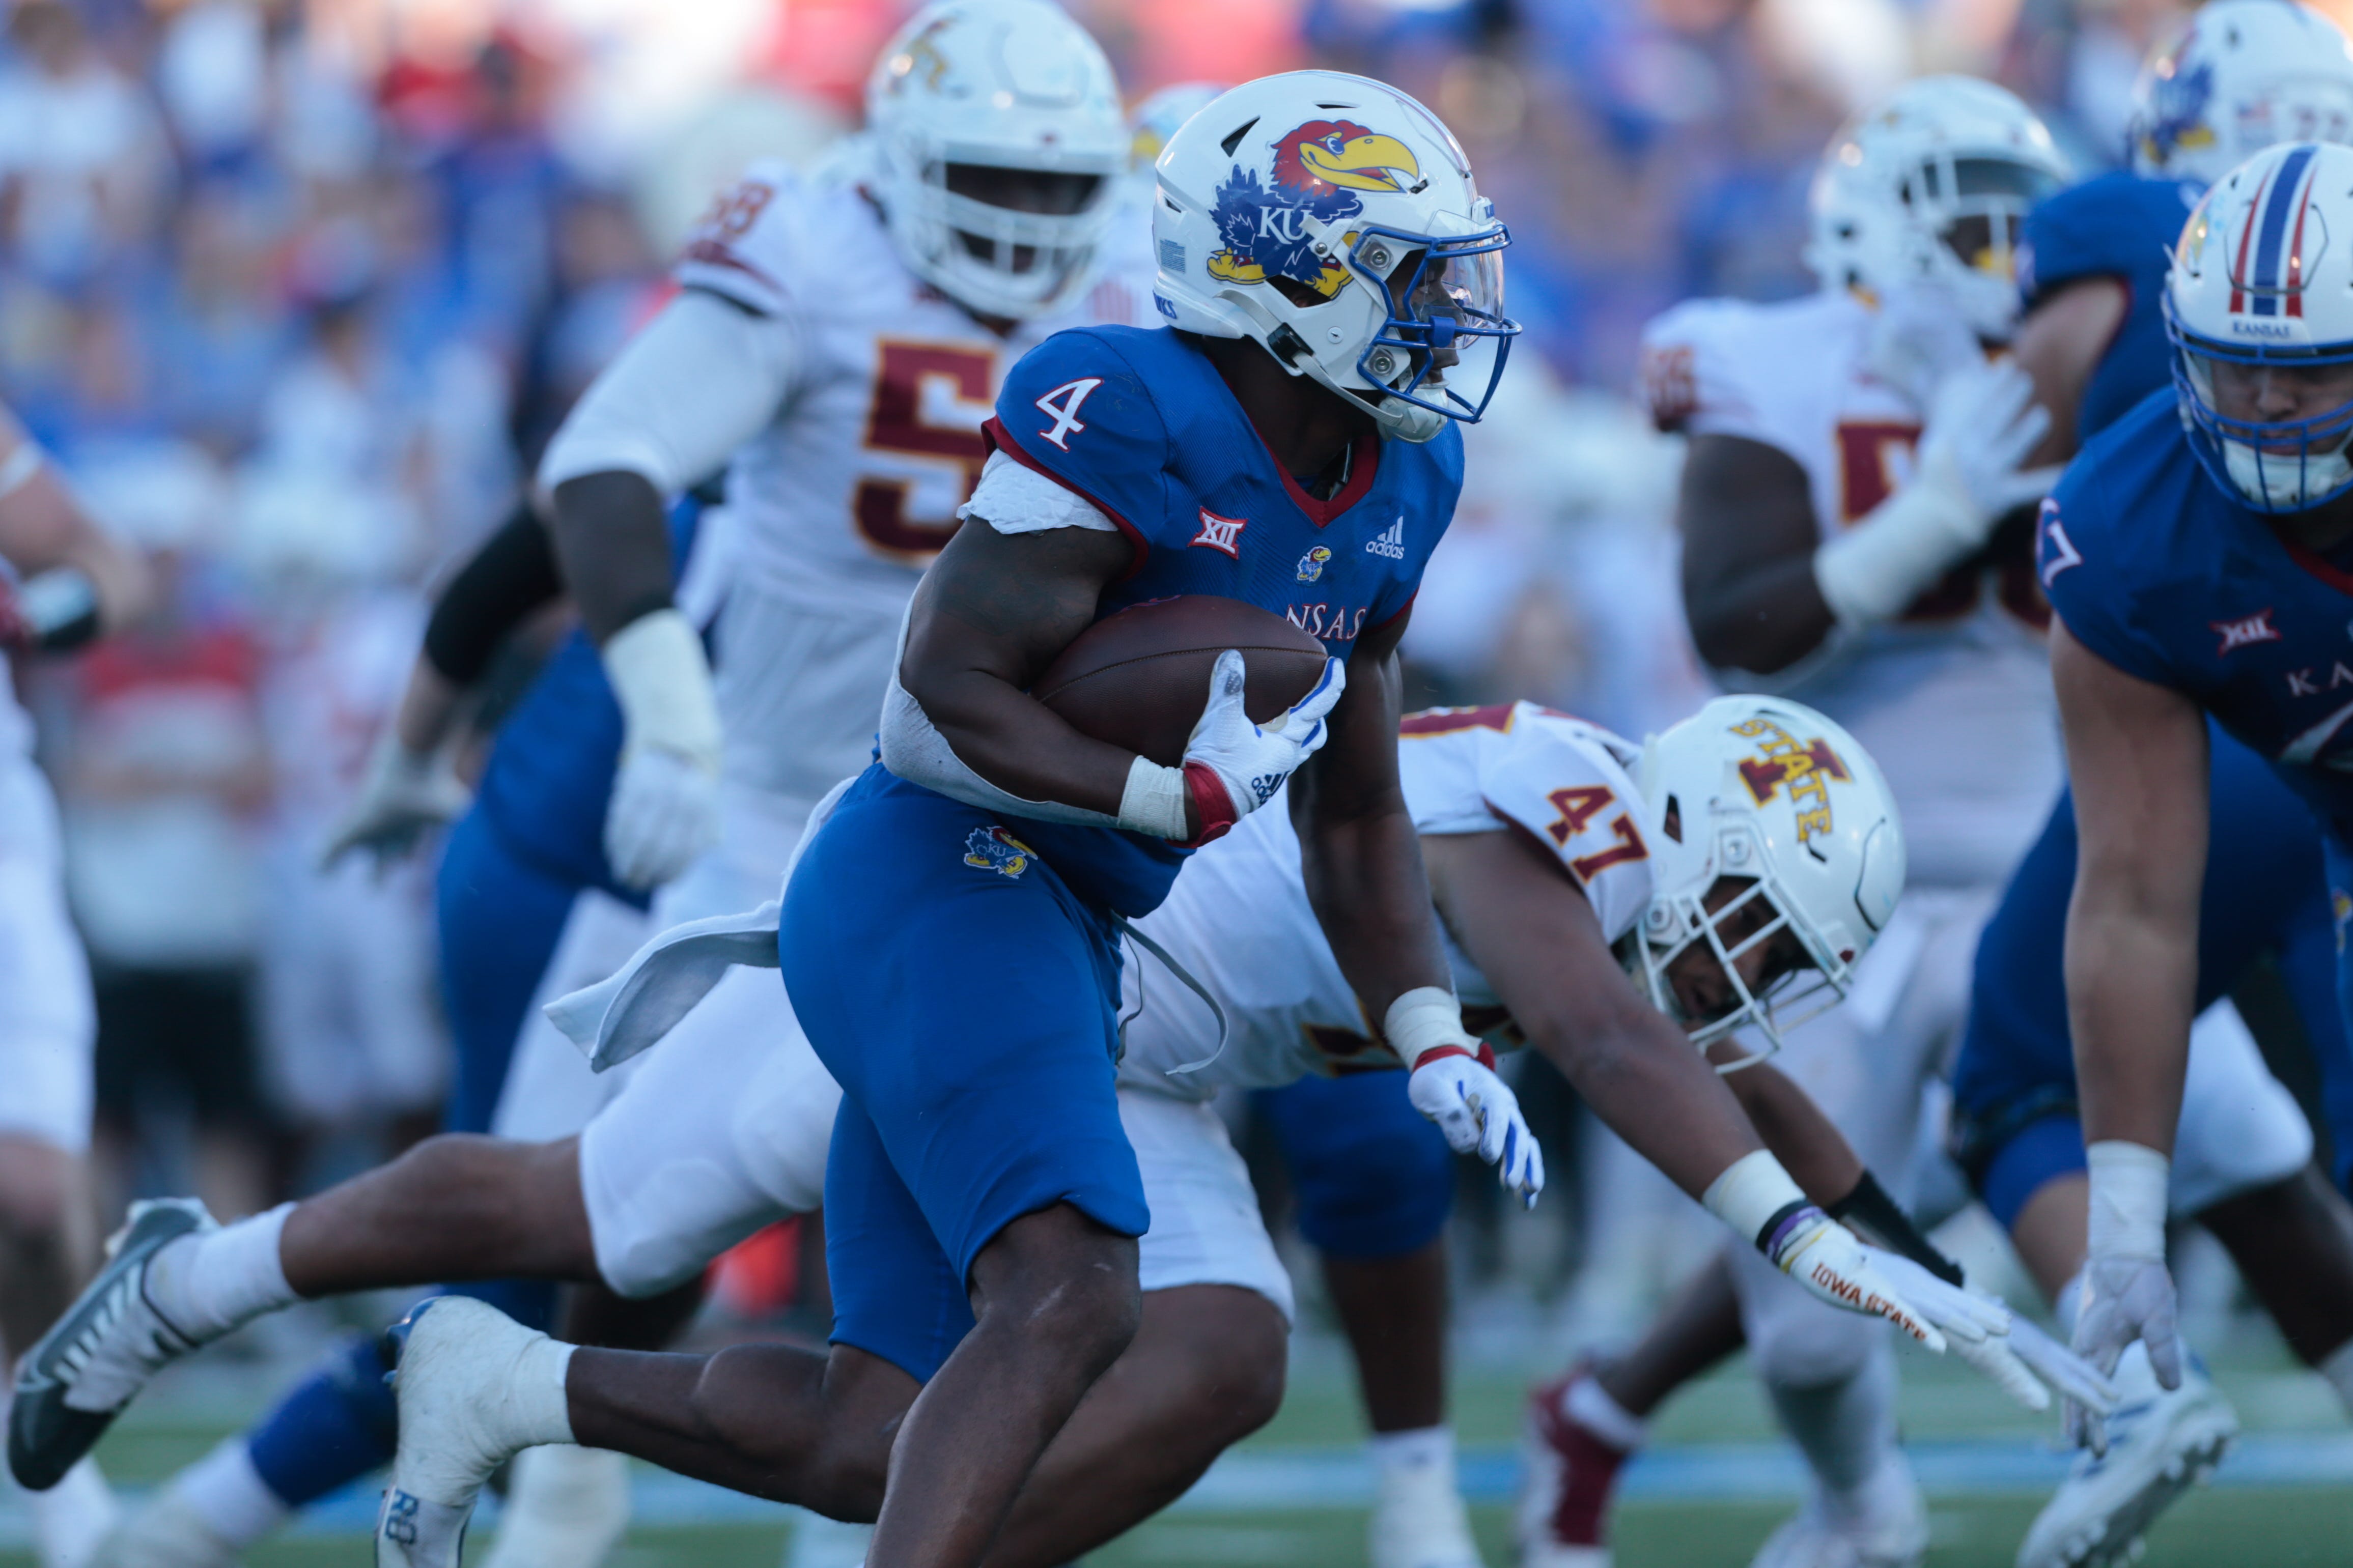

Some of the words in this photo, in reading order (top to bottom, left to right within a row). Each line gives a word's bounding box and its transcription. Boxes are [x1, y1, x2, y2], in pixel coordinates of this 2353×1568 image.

[1257, 206, 1313, 245] KU
[1034, 377, 1104, 452] 4
[1192, 509, 1245, 556] XII
[1365, 540, 1405, 560] adidas
[1729, 719, 1832, 843] STATE
[988, 843, 1006, 856] KU
[1546, 784, 1650, 885] 47
[1811, 1262, 1863, 1306] IOWA
[1864, 1293, 1927, 1341] STATE
